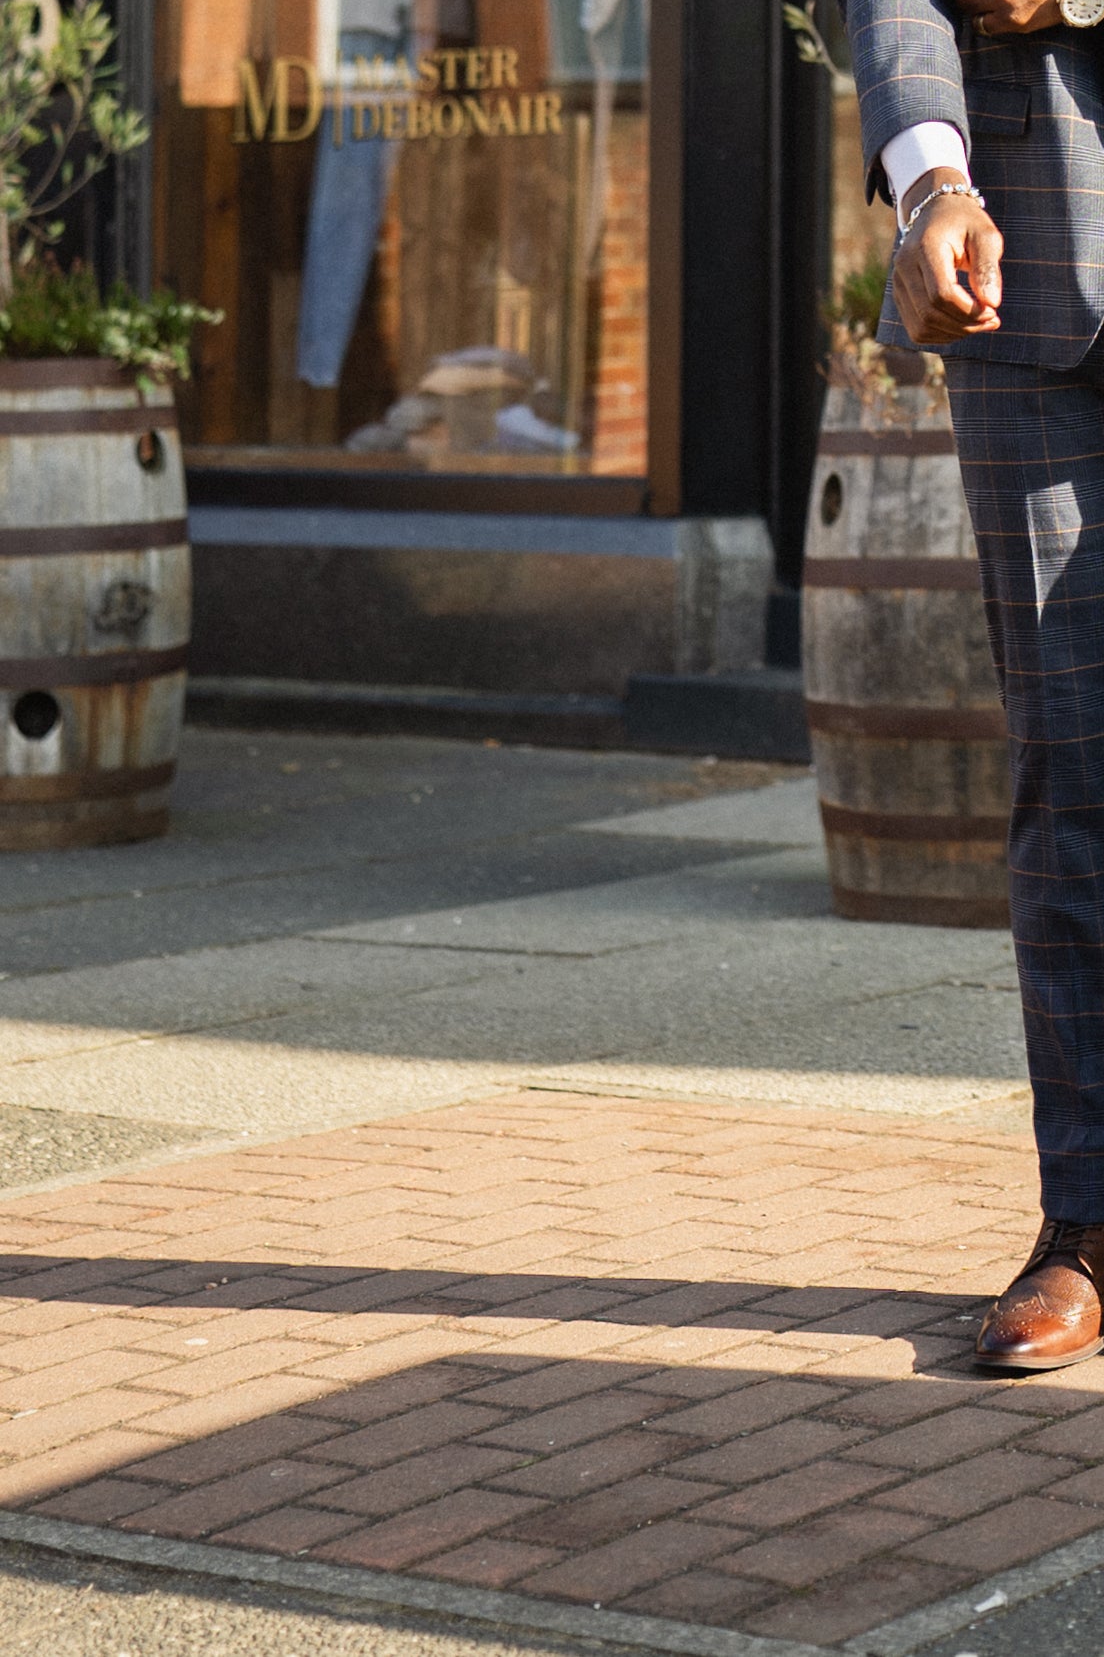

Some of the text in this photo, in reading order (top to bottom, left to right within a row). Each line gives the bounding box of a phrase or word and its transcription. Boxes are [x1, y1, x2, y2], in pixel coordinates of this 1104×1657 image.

[353, 45, 519, 92] MASTER
[233, 55, 325, 143] MD
[353, 92, 564, 141] DEBONAIR
